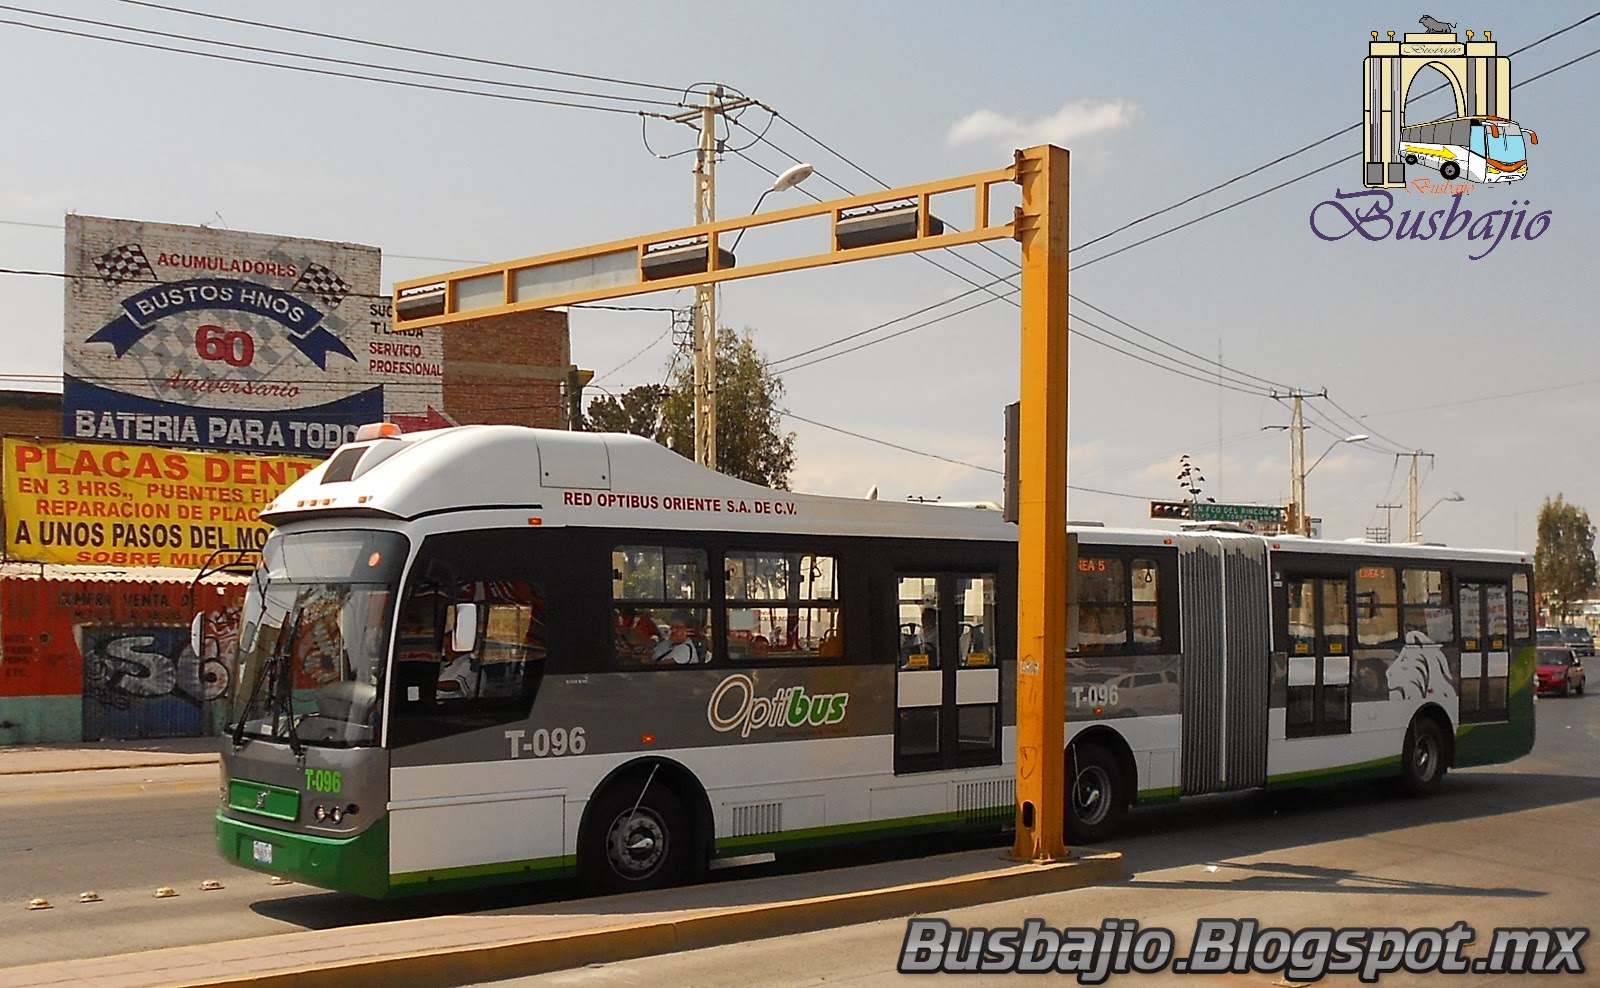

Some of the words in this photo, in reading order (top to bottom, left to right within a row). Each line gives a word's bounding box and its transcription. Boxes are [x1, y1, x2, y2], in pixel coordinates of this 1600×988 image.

[158, 252, 297, 278] ACUMULADORES
[135, 285, 234, 316] BUSTOS
[240, 289, 305, 323] HNOS
[195, 324, 255, 367] 60
[369, 341, 422, 359] SERVICIO
[369, 359, 443, 376] PROFESIONAL
[162, 369, 301, 398] Aniversario
[75, 409, 199, 443] BATERIA
[208, 417, 286, 447] PARA
[289, 421, 359, 449] TODO
[15, 445, 189, 481] PLACAS
[204, 457, 314, 487] DENT
[18, 478, 49, 495] EN
[58, 480, 70, 495] 3
[147, 483, 244, 503] PUENTES
[251, 488, 280, 504] FIJ
[564, 492, 593, 506] RED
[599, 494, 659, 510] OPTIBUS
[663, 497, 721, 512] ORIENTE
[726, 500, 751, 514] S.A.
[755, 501, 771, 515] DE
[774, 502, 797, 515] C.V.
[36, 499, 170, 519] REPARACION
[178, 504, 203, 520] DE
[209, 506, 261, 523] PLAC
[15, 520, 32, 545] A
[39, 521, 105, 547] UNOS
[112, 523, 182, 548] PASOS
[190, 525, 230, 550] DEL
[236, 527, 275, 550] MO
[76, 552, 161, 565] SOBRE
[707, 673, 850, 738] Optibus
[1072, 684, 1119, 708] T-096
[505, 727, 587, 758] T-096
[305, 768, 342, 794] T-096
